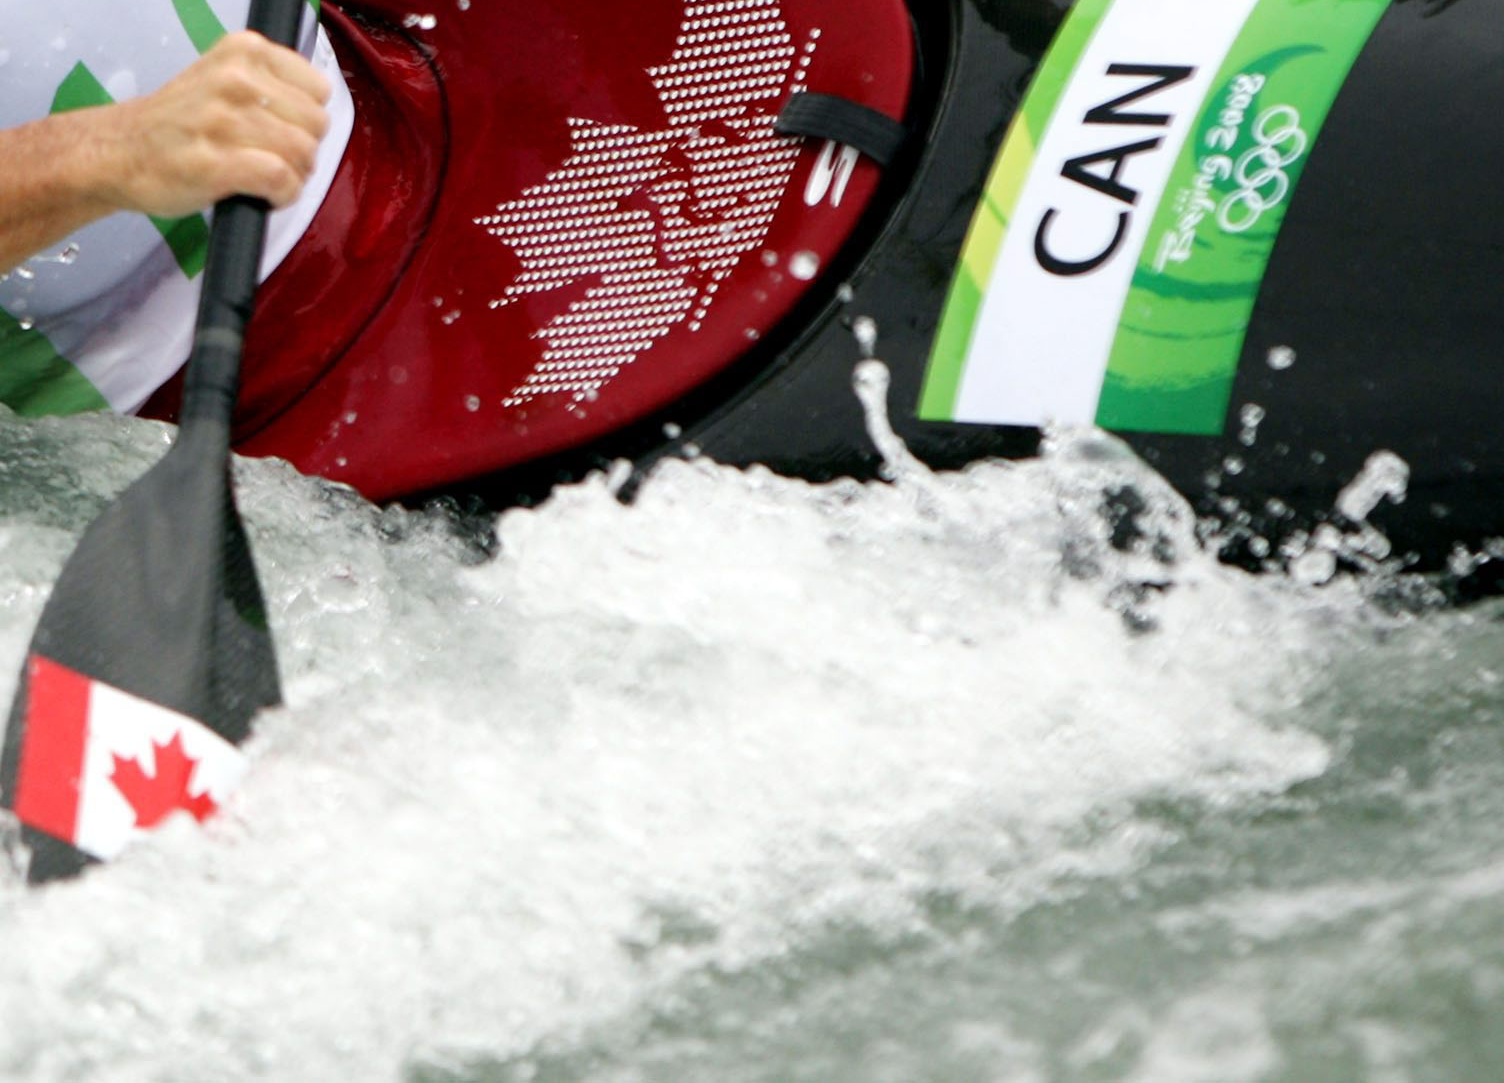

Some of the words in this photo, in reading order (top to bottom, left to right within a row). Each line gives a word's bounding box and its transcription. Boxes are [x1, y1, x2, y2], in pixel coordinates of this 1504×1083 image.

[1033, 63, 1198, 277] CAN
[1152, 154, 1233, 274] Beijing
[1204, 72, 1266, 152] 2008
